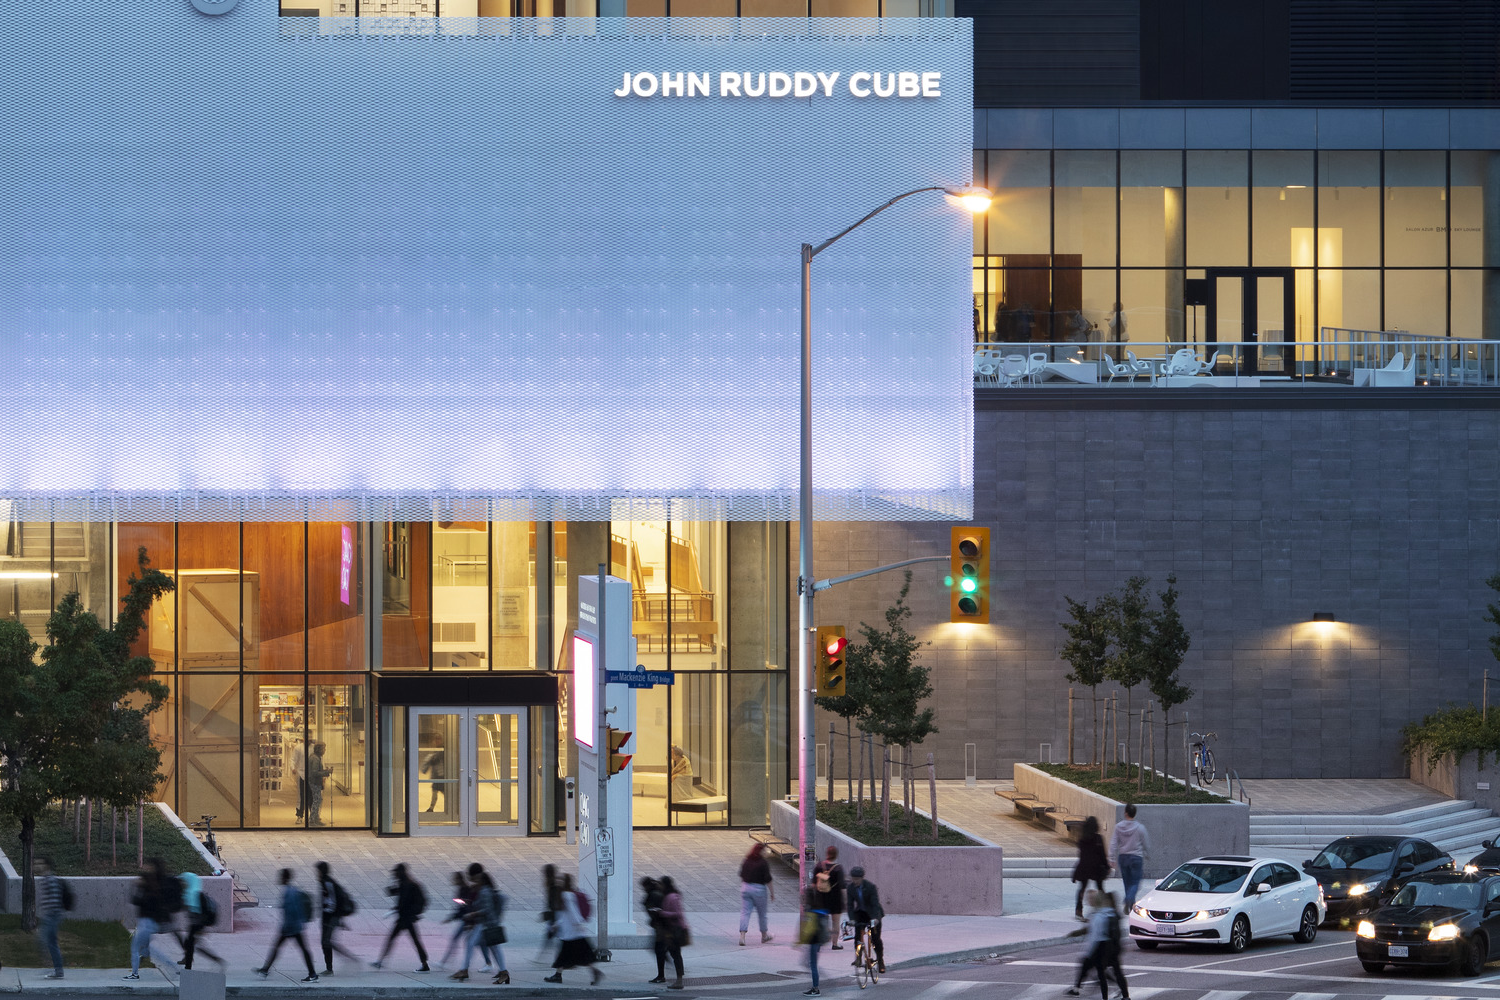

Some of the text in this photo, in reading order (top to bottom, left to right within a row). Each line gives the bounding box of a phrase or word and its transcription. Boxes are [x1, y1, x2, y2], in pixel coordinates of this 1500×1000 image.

[614, 71, 942, 98] JOHN RUDDY CUBE
[619, 672, 646, 682] Mackenzie
[647, 673, 659, 685] King
